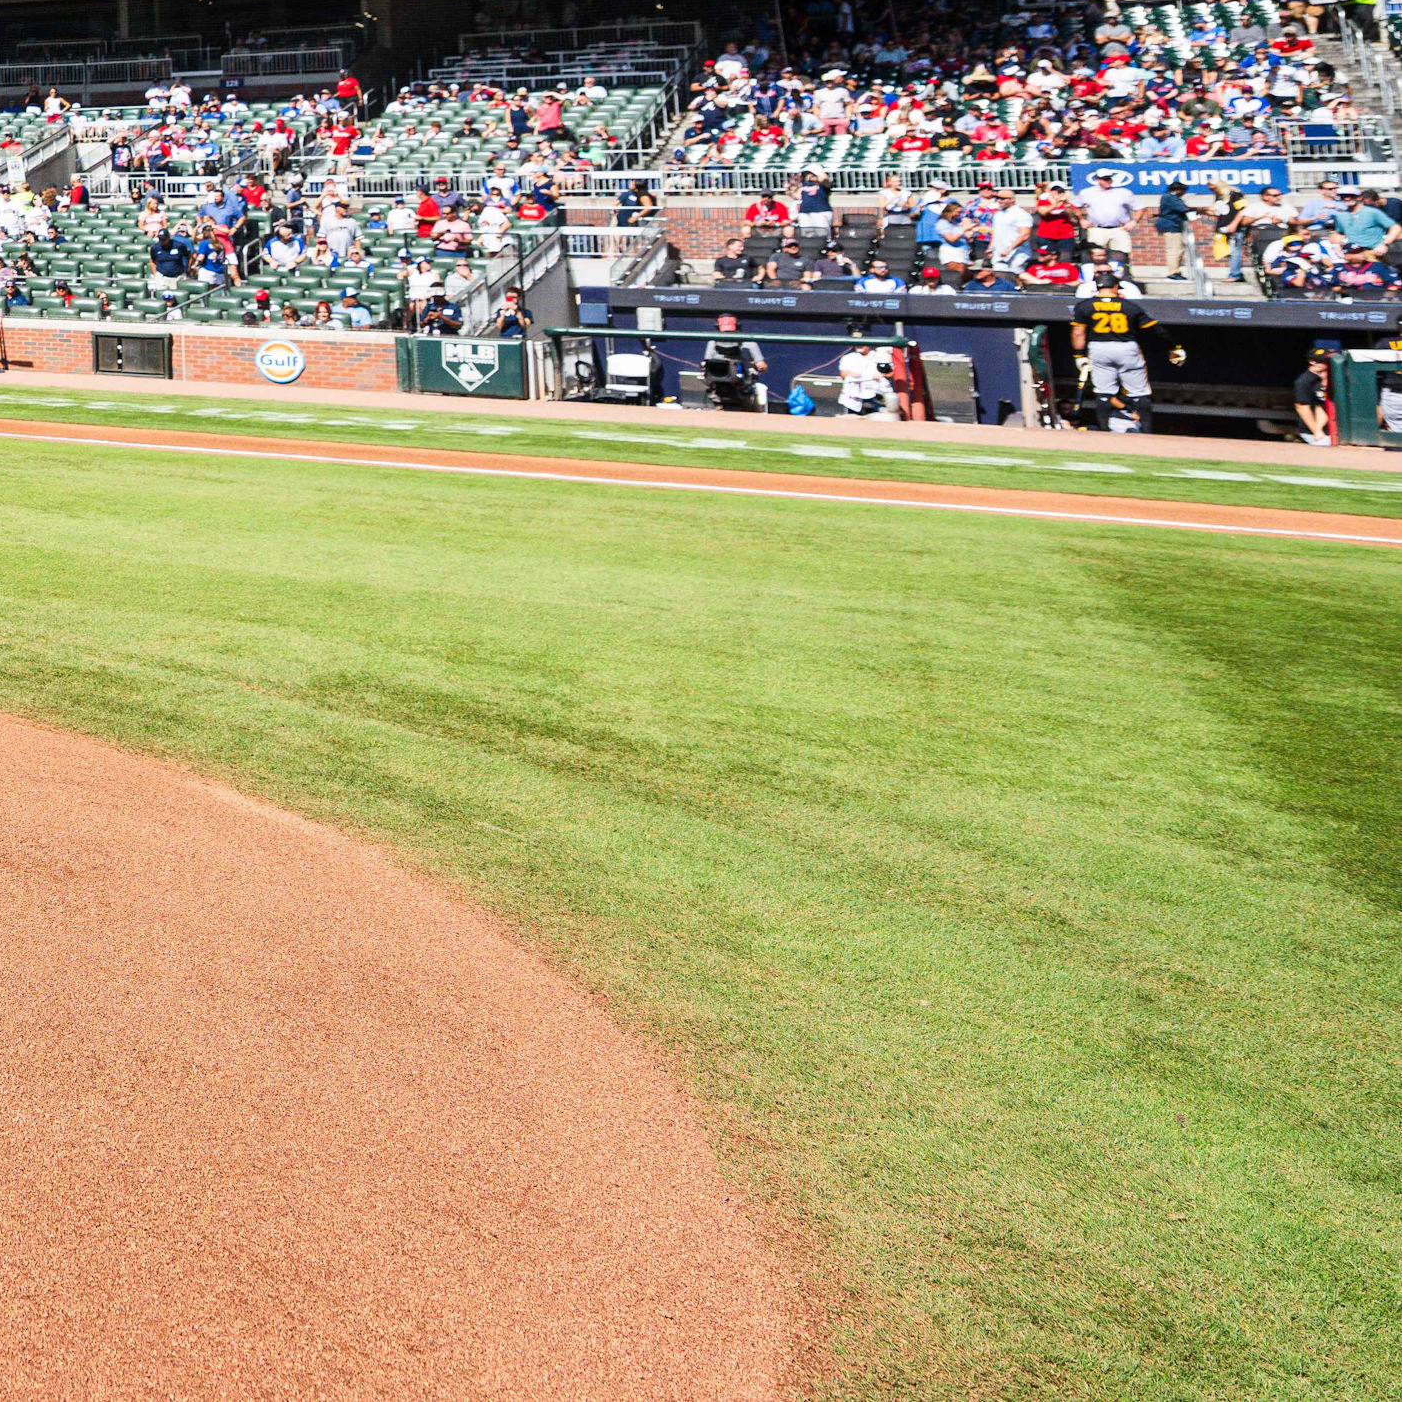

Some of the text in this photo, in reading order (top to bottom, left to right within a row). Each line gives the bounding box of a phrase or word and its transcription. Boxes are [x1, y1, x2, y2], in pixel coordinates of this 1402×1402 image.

[1139, 169, 1272, 186] HYUNDAI
[848, 300, 884, 308] TRUIST
[954, 302, 992, 310] TRUIST
[1188, 308, 1232, 317] TRUIST
[1320, 311, 1366, 320] TRUIST
[1092, 312, 1129, 334] 28
[445, 343, 495, 359] MLB
[260, 354, 297, 366] Gulf
